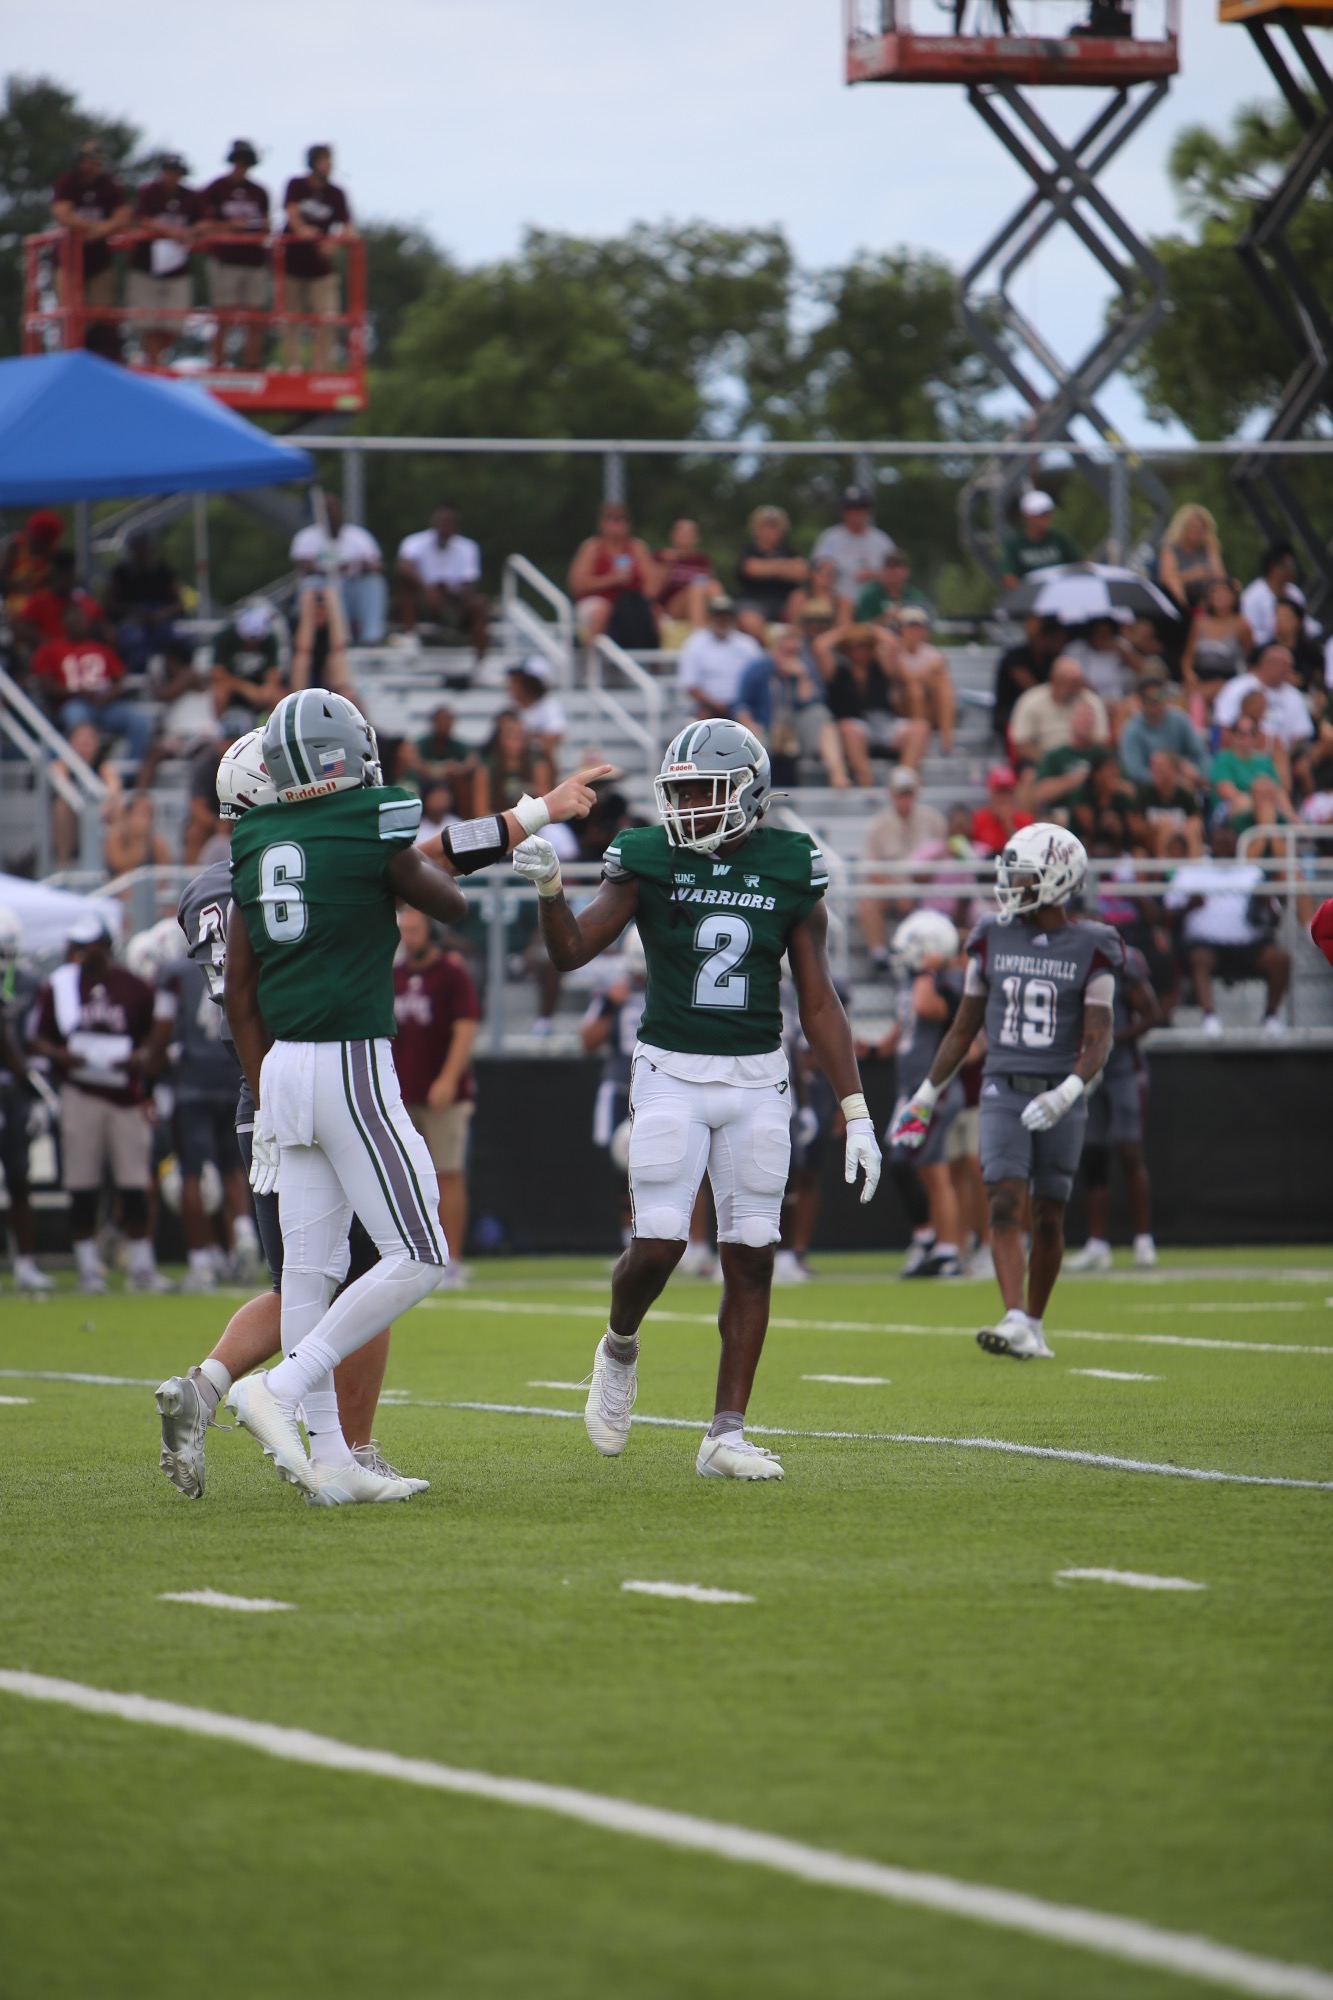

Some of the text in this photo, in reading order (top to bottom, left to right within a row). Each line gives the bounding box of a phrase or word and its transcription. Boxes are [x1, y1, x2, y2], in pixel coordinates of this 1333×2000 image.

[285, 780, 338, 801] Riddell
[258, 840, 309, 945] 6
[670, 887, 776, 910] WARRIORS
[691, 911, 752, 1010] 2
[993, 953, 1078, 981] CAMPBELLSVILLE
[999, 975, 1059, 1048] 19
